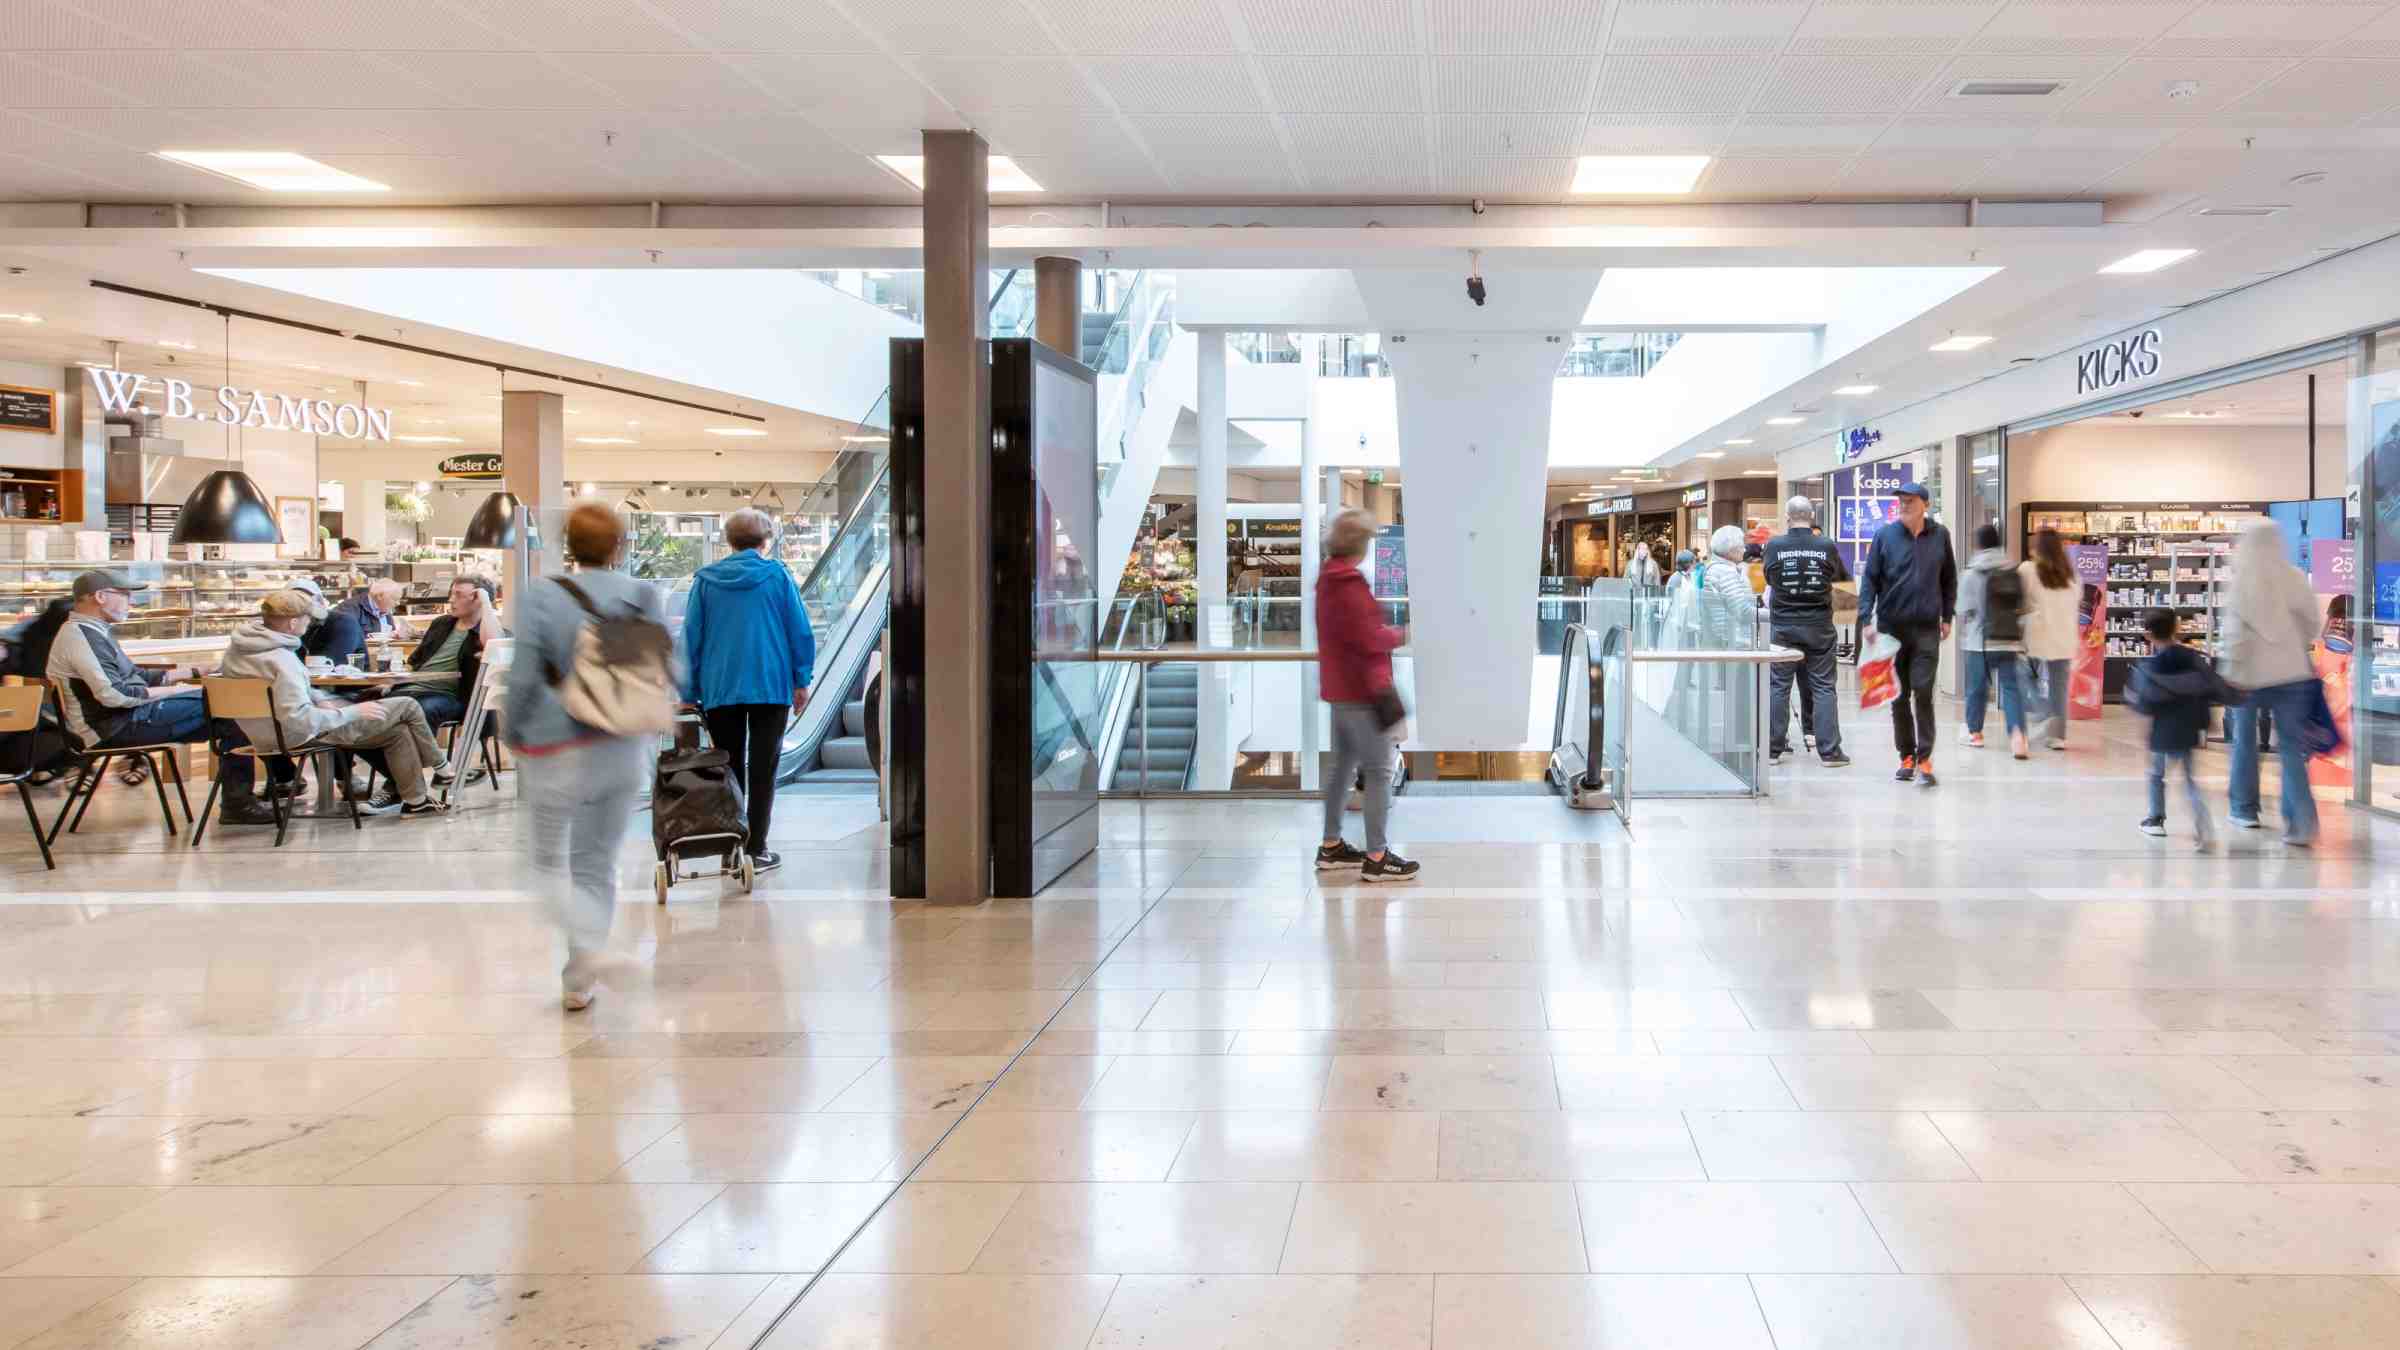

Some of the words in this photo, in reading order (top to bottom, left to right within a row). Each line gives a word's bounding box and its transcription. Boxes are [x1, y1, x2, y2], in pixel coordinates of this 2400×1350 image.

[2077, 330, 2159, 394] KICKS
[86, 366, 150, 415] W.
[163, 377, 206, 422] B.
[217, 385, 393, 441] SAMSON
[443, 458, 484, 472] Mester
[1853, 473, 1900, 489] Kasse
[2078, 557, 2105, 569] 25%
[2331, 556, 2356, 573] 25
